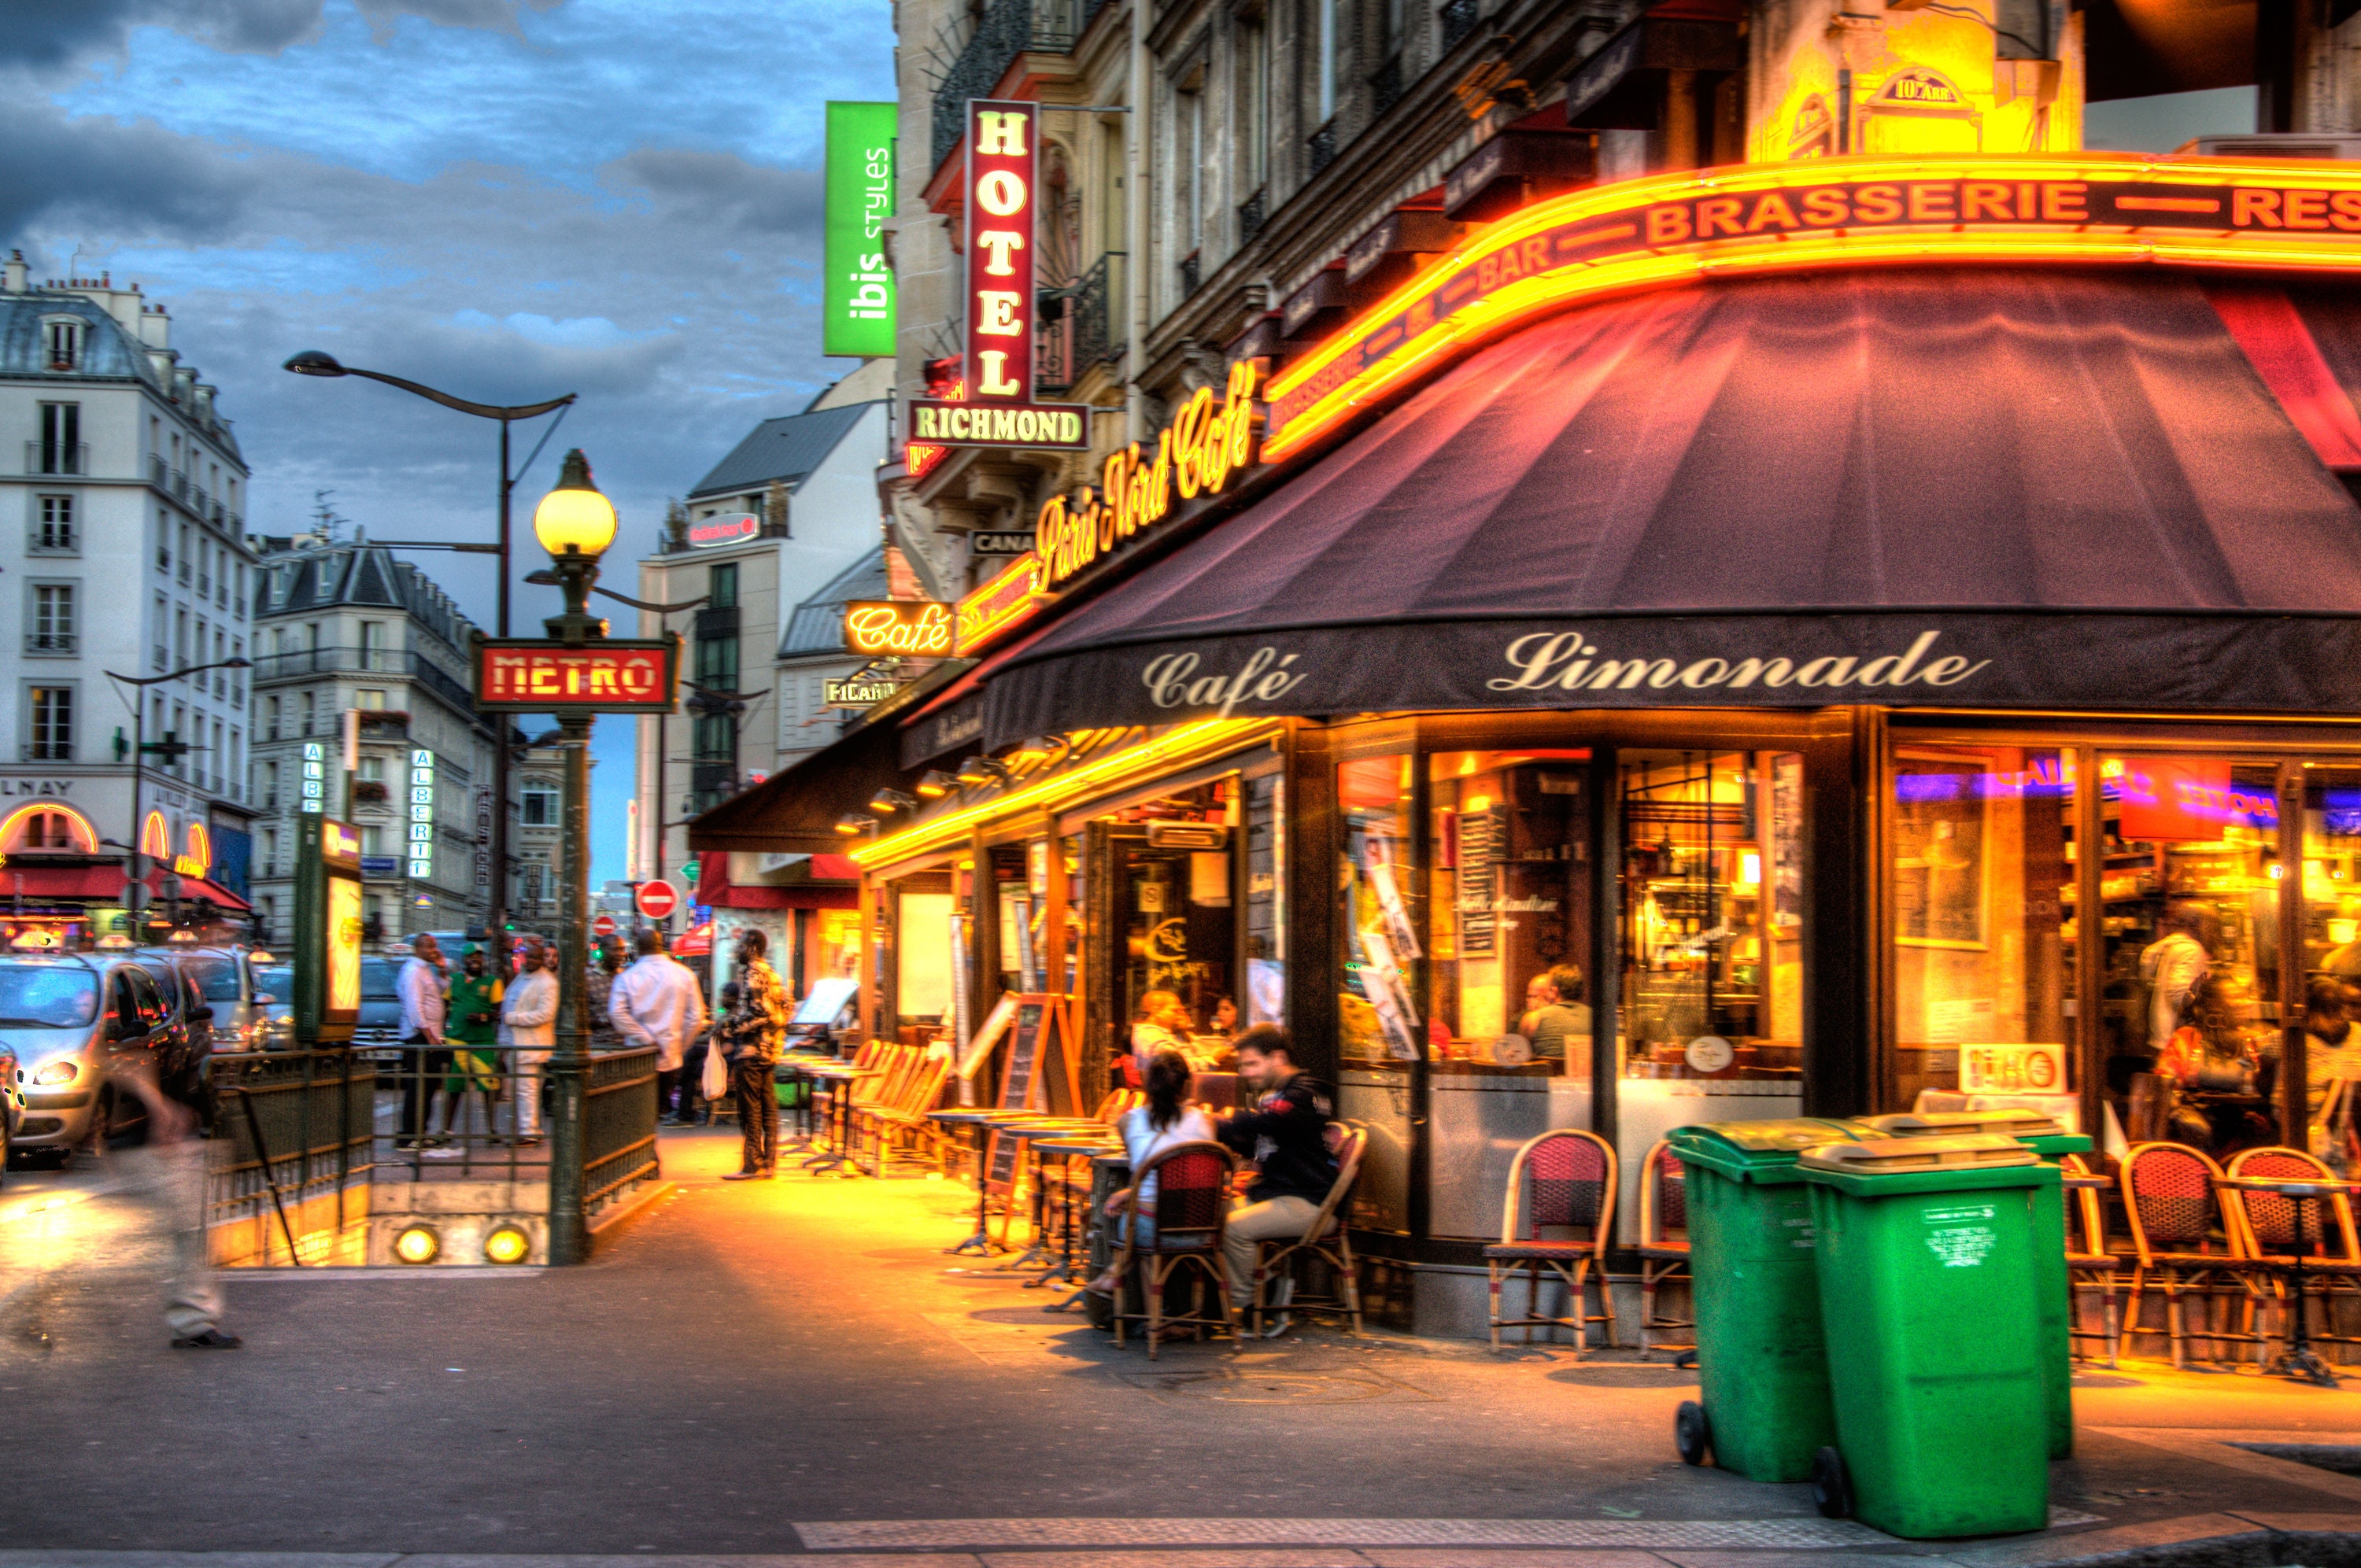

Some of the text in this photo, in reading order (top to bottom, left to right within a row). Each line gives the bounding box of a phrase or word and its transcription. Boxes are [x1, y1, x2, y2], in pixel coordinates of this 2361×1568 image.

[976, 110, 1029, 396] HOTEL
[1476, 234, 1552, 293] BAR
[1646, 181, 2090, 245] BRASSERIE
[2232, 187, 2361, 231] RES
[849, 253, 888, 319] ibis
[915, 407, 1083, 443] RICHMOND
[1036, 487, 1100, 592] Paris
[1173, 359, 1254, 499] Café
[848, 603, 953, 652] Café
[492, 656, 656, 695] METRO
[1142, 630, 1993, 719] Café Limonade
[415, 751, 430, 856] ALBERT
